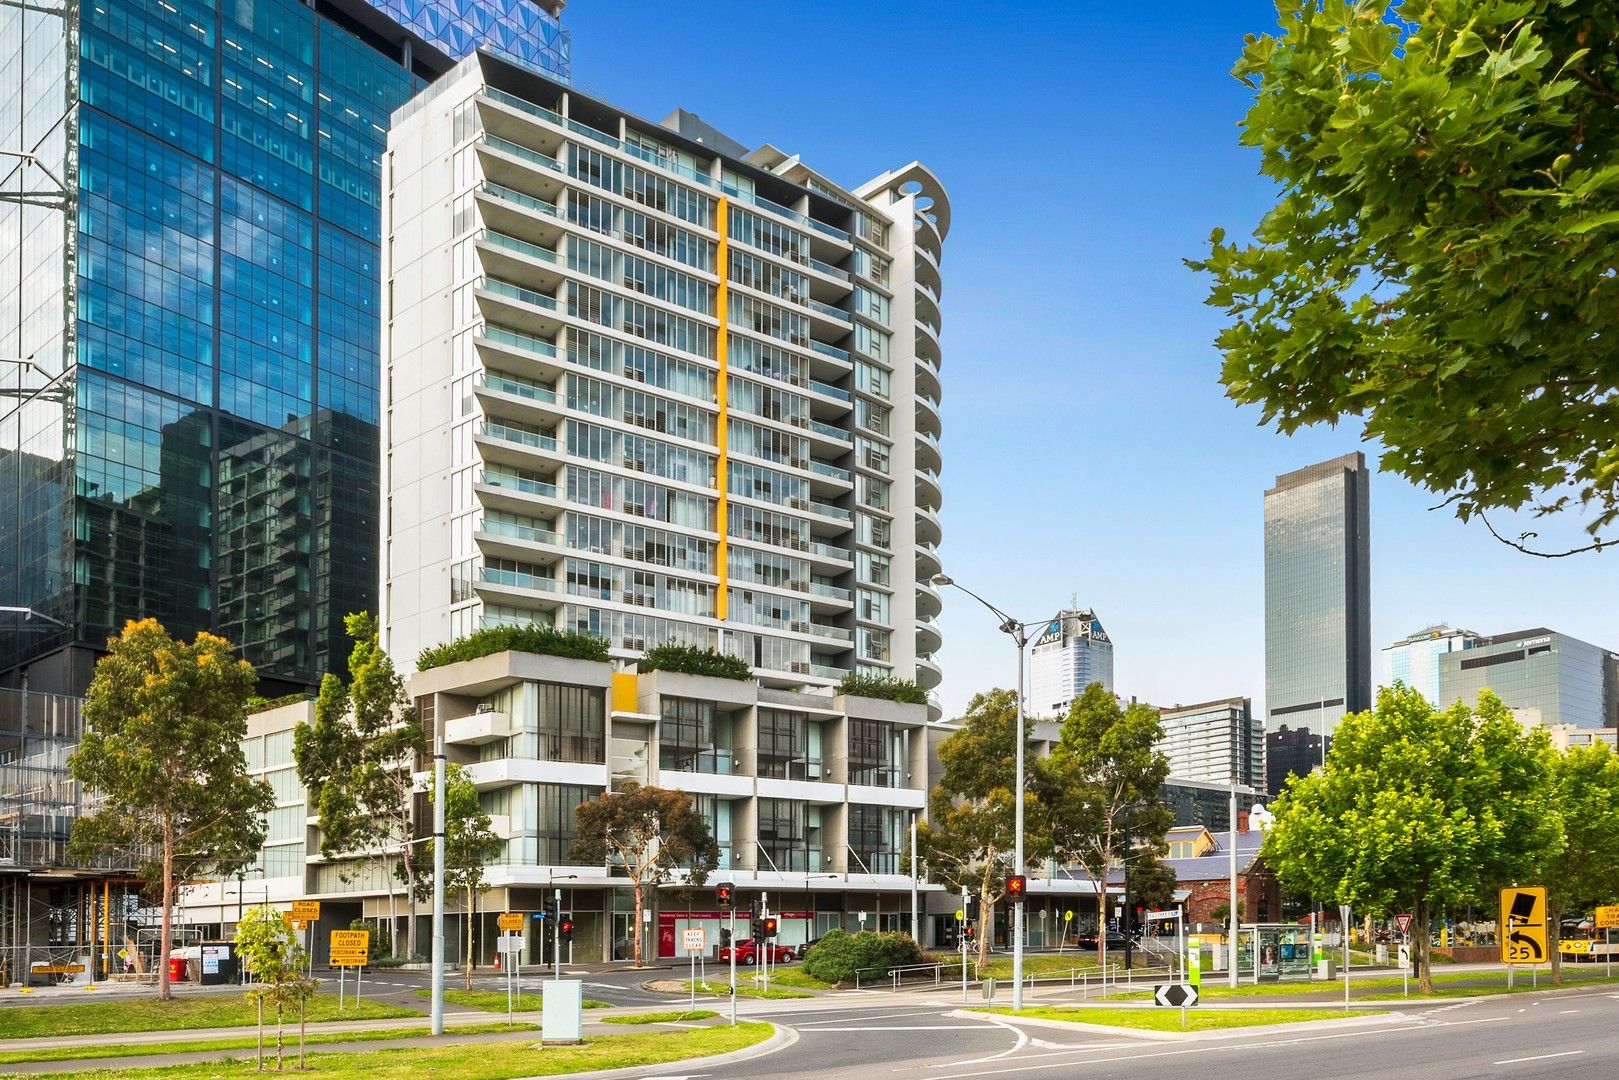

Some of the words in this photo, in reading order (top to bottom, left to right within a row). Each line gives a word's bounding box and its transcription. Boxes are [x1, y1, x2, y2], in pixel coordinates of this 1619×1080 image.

[1040, 632, 1060, 644] AMP
[1092, 631, 1107, 641] AMP
[1510, 947, 1530, 959] 25
